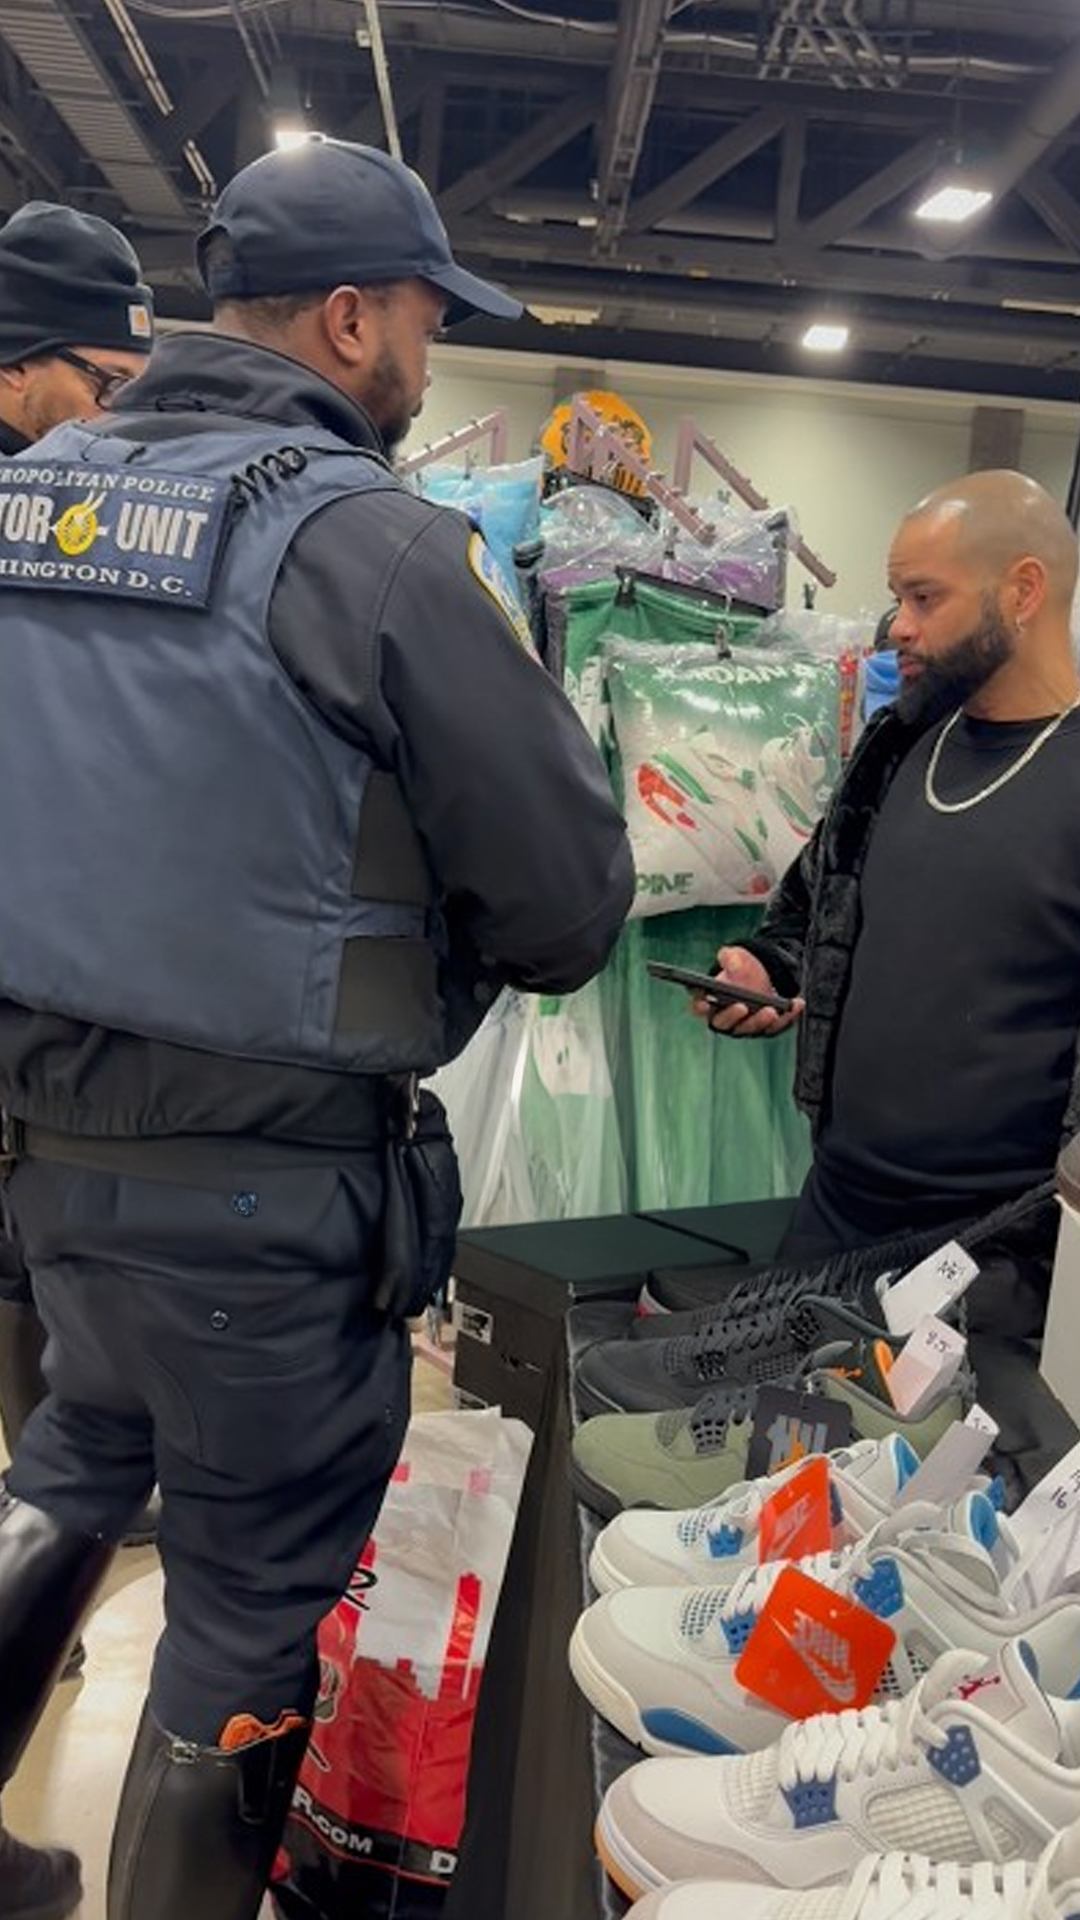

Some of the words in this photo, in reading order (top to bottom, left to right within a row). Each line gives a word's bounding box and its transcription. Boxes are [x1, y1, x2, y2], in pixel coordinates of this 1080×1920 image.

[122, 476, 215, 502] POLICE
[116, 501, 209, 560] UNIT
[127, 570, 192, 597] D.C.
